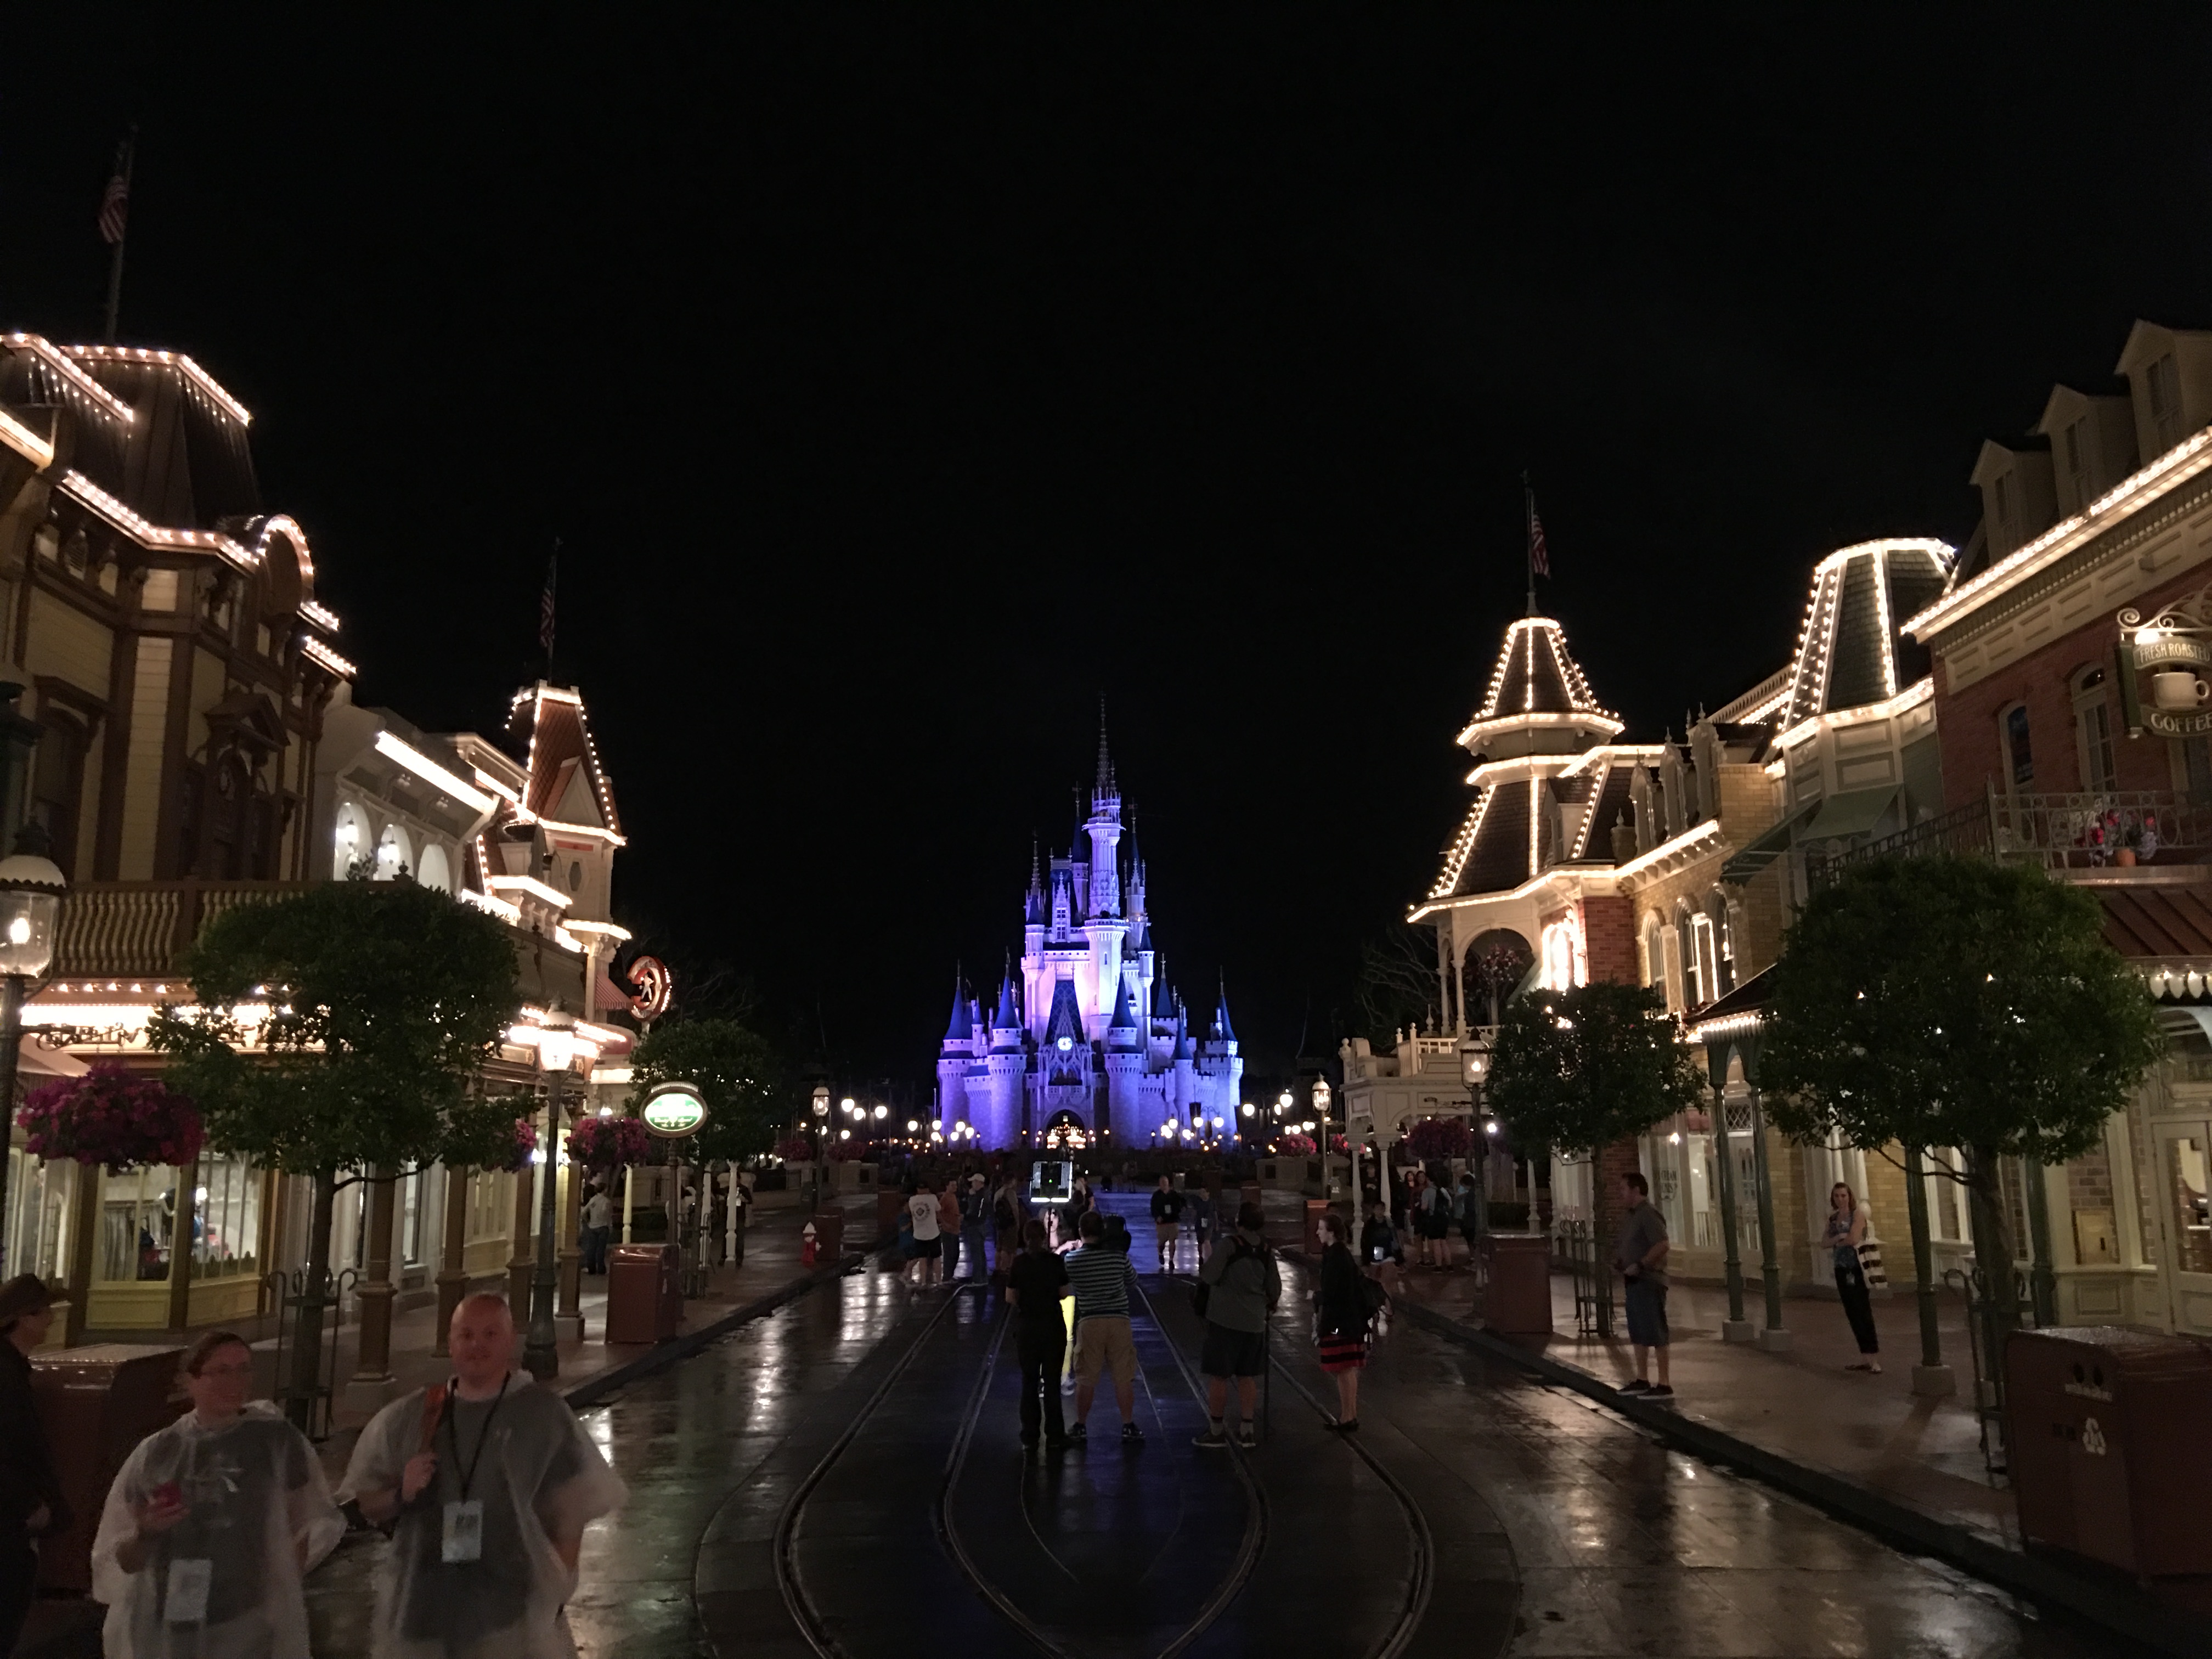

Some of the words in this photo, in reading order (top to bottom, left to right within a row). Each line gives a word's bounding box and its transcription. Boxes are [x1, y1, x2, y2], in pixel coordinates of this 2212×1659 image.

[2140, 644, 2167, 663] FRESH
[2168, 643, 2210, 662] ROASTED
[2151, 713, 2212, 732] COFFEE
